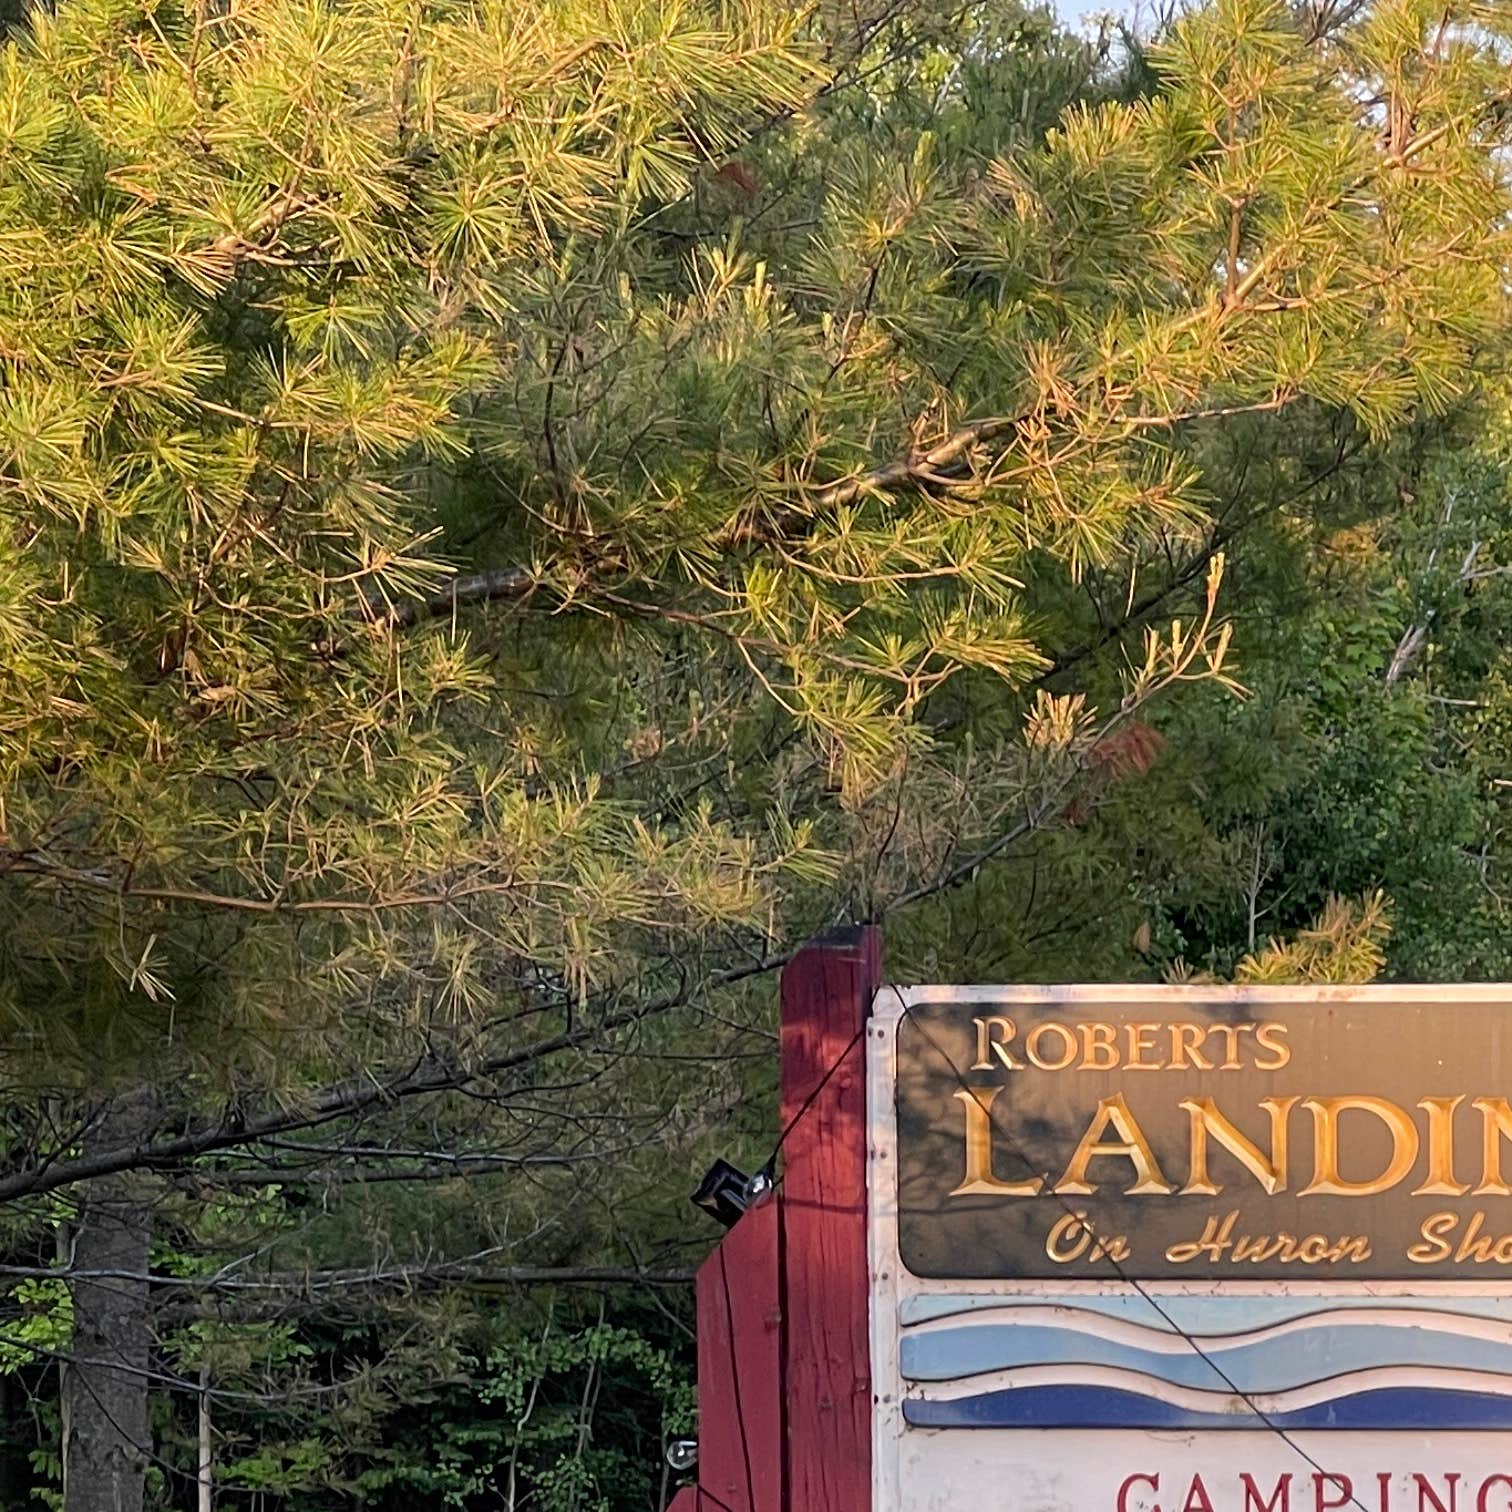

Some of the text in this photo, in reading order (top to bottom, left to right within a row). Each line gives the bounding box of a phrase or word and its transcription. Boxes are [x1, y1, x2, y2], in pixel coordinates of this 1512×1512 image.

[971, 1016, 1292, 1072] ROBERTS
[1044, 1210, 1130, 1265] On
[1164, 1210, 1373, 1265] Huron
